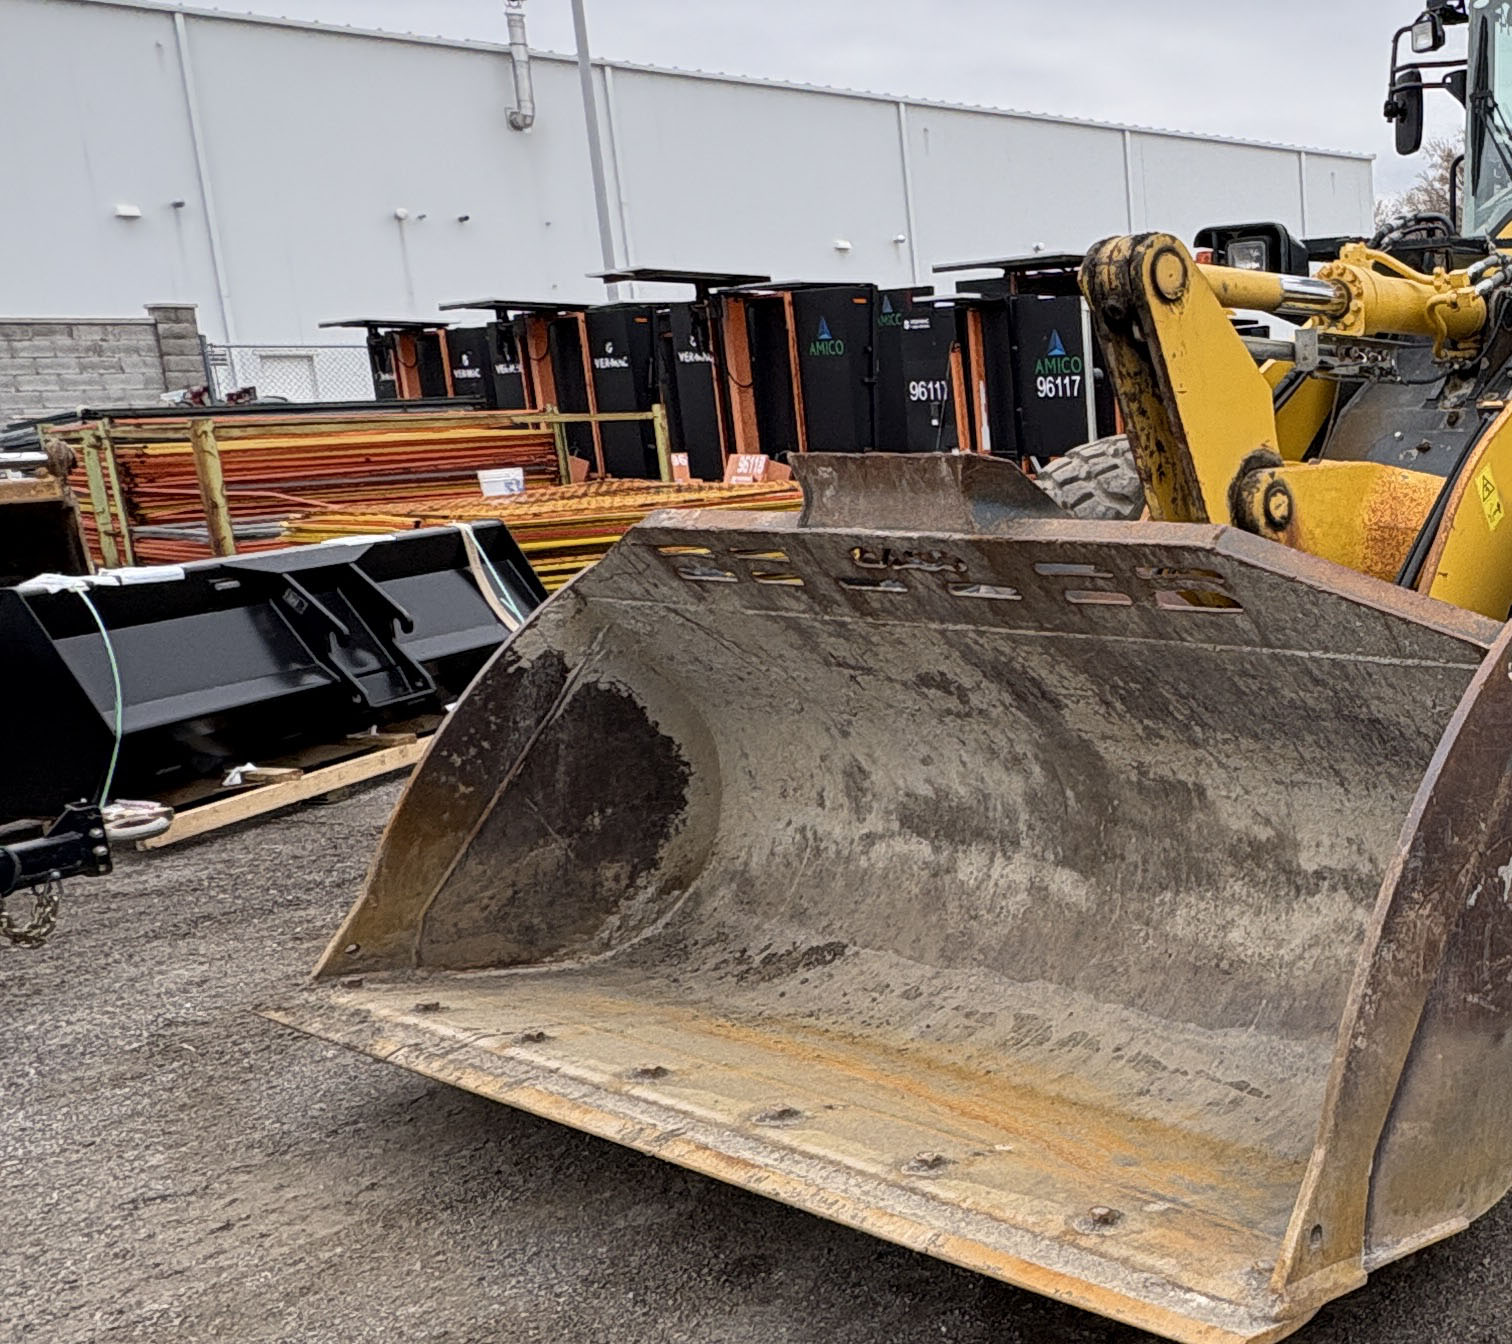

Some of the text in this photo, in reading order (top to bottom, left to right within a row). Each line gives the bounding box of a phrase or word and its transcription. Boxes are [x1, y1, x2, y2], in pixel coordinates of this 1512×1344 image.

[809, 339, 844, 356] AMICO
[1034, 356, 1082, 375] AMICO
[1036, 375, 1081, 397] 96117
